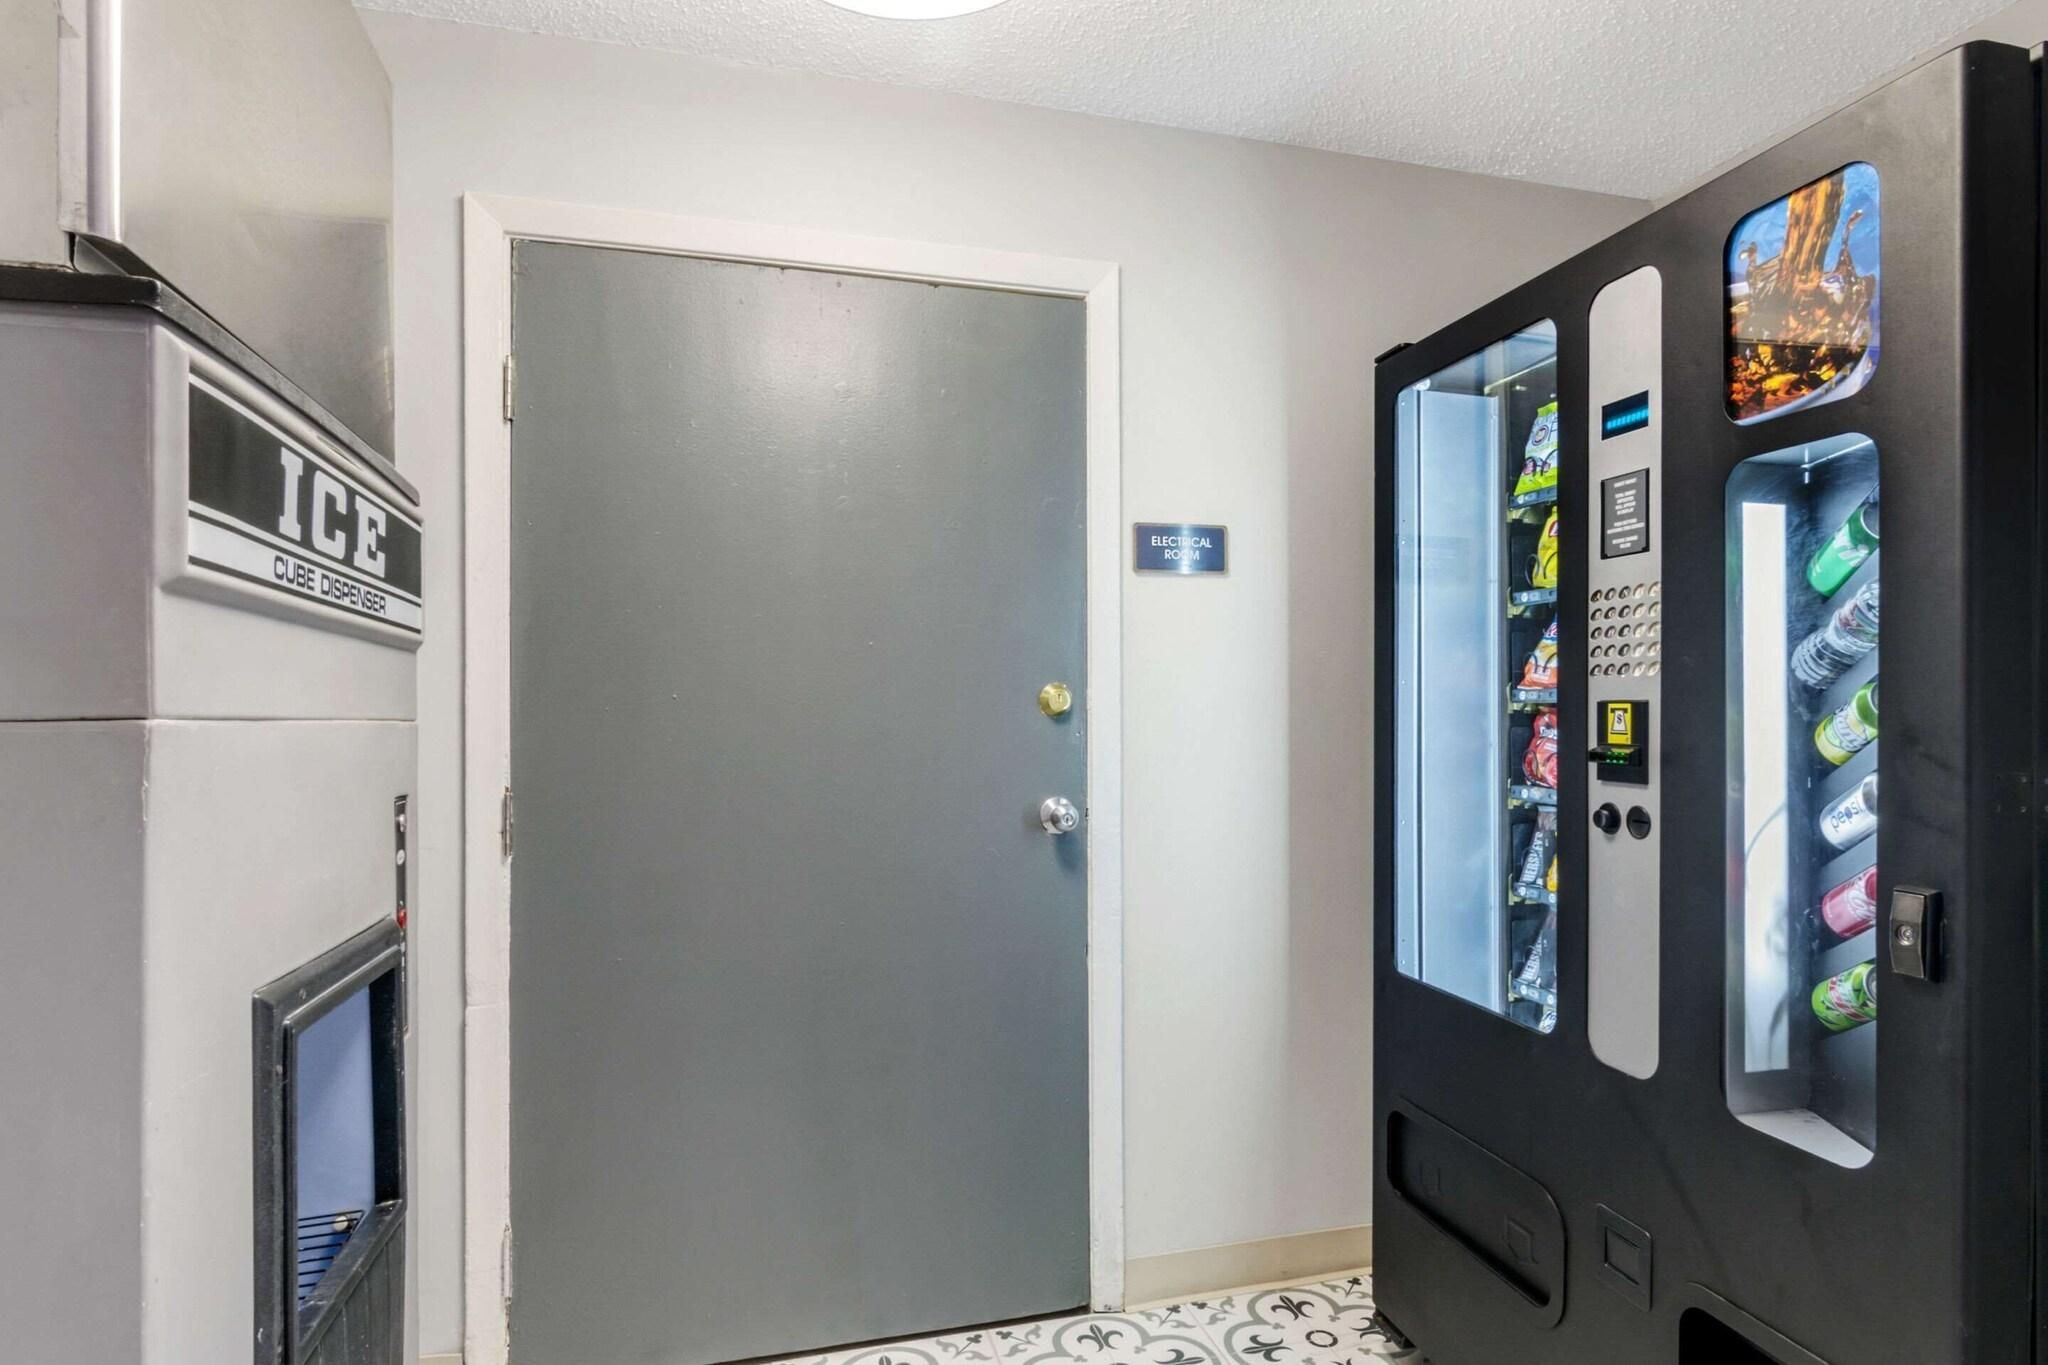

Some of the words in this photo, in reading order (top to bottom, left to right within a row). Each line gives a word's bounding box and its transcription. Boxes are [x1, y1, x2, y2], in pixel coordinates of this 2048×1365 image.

[278, 447, 386, 578] ICE
[1151, 535, 1212, 548] ELECTRICAL
[1164, 549, 1200, 561] ROOM
[273, 555, 316, 591] CUBE
[320, 574, 386, 615] DISPENSER
